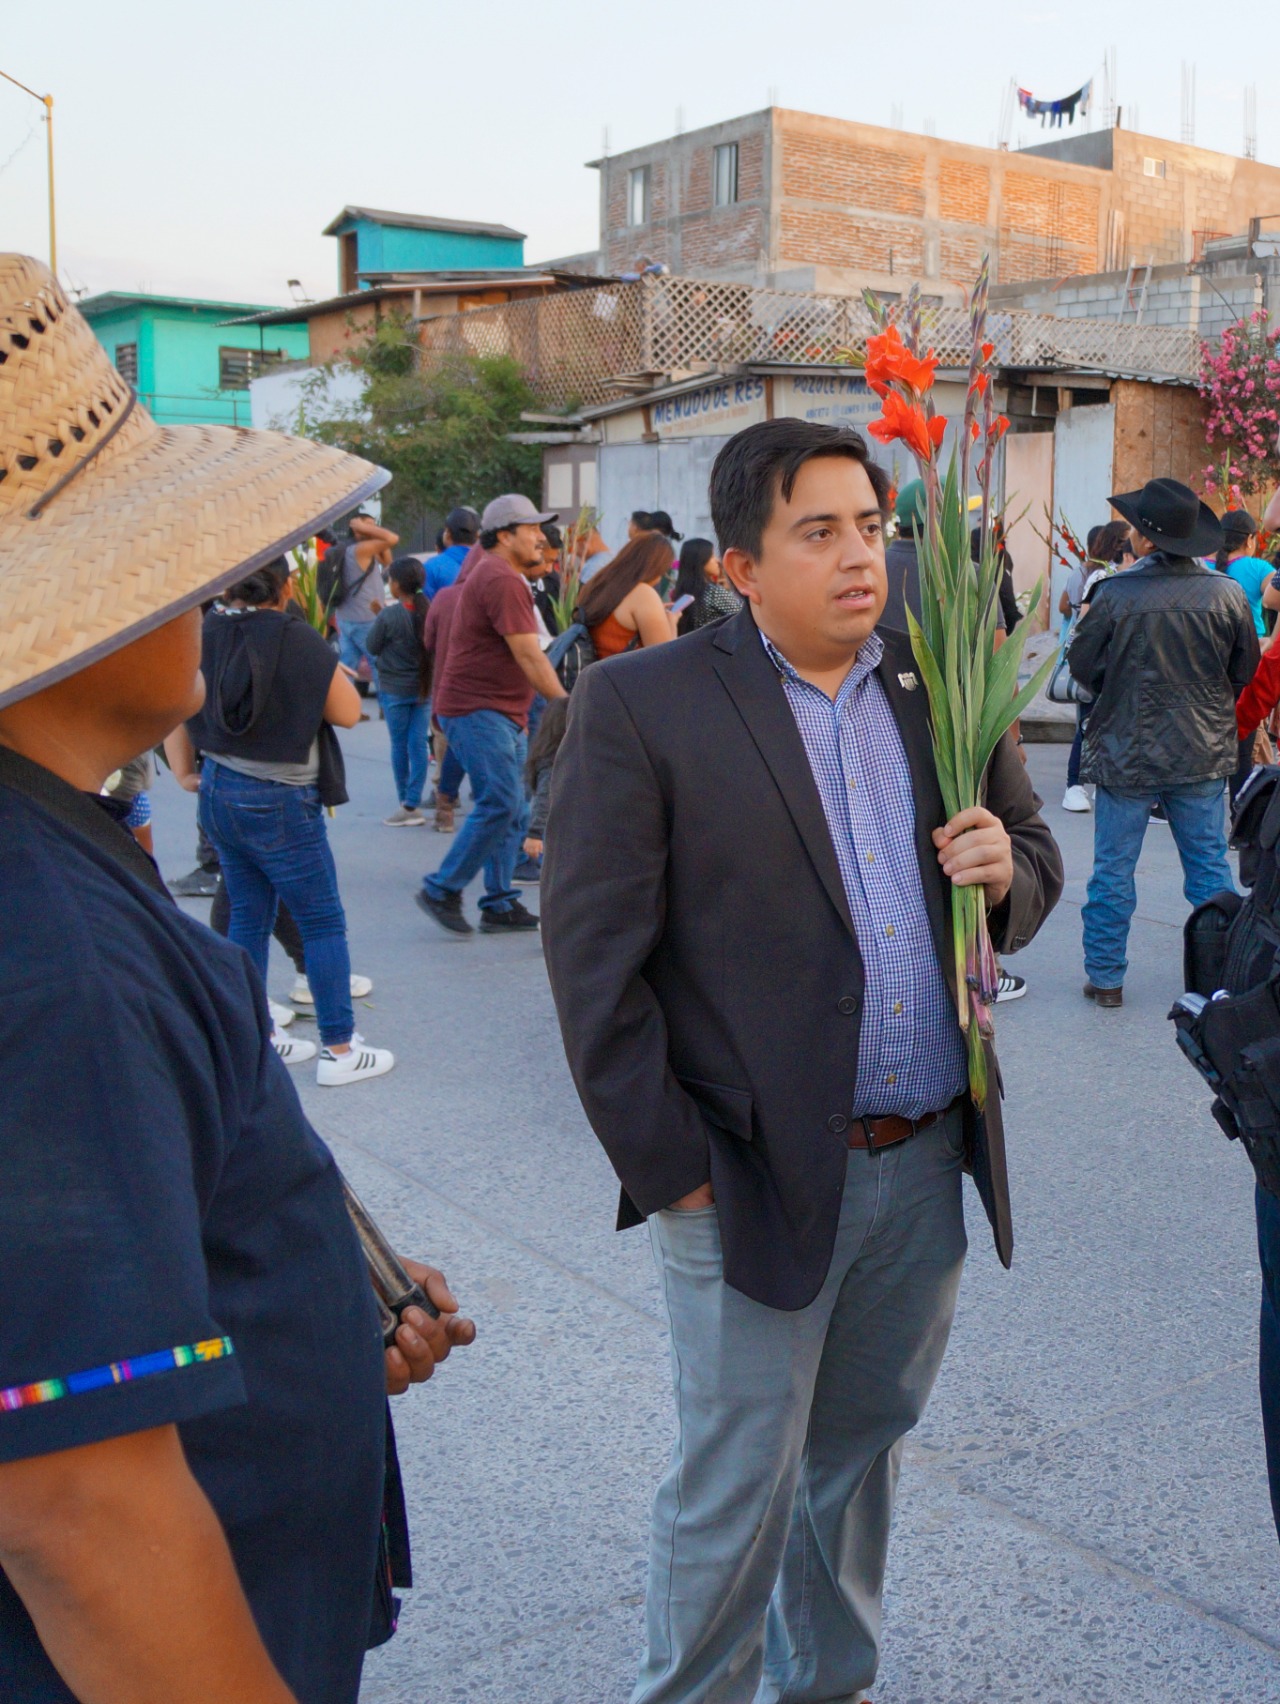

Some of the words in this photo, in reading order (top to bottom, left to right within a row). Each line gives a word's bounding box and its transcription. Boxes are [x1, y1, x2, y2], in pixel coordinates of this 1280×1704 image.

[654, 387, 711, 425] MENUDO
[712, 384, 730, 410] DE
[734, 377, 764, 403] RES
[793, 376, 836, 395] POZOLE
[838, 377, 848, 395] Y
